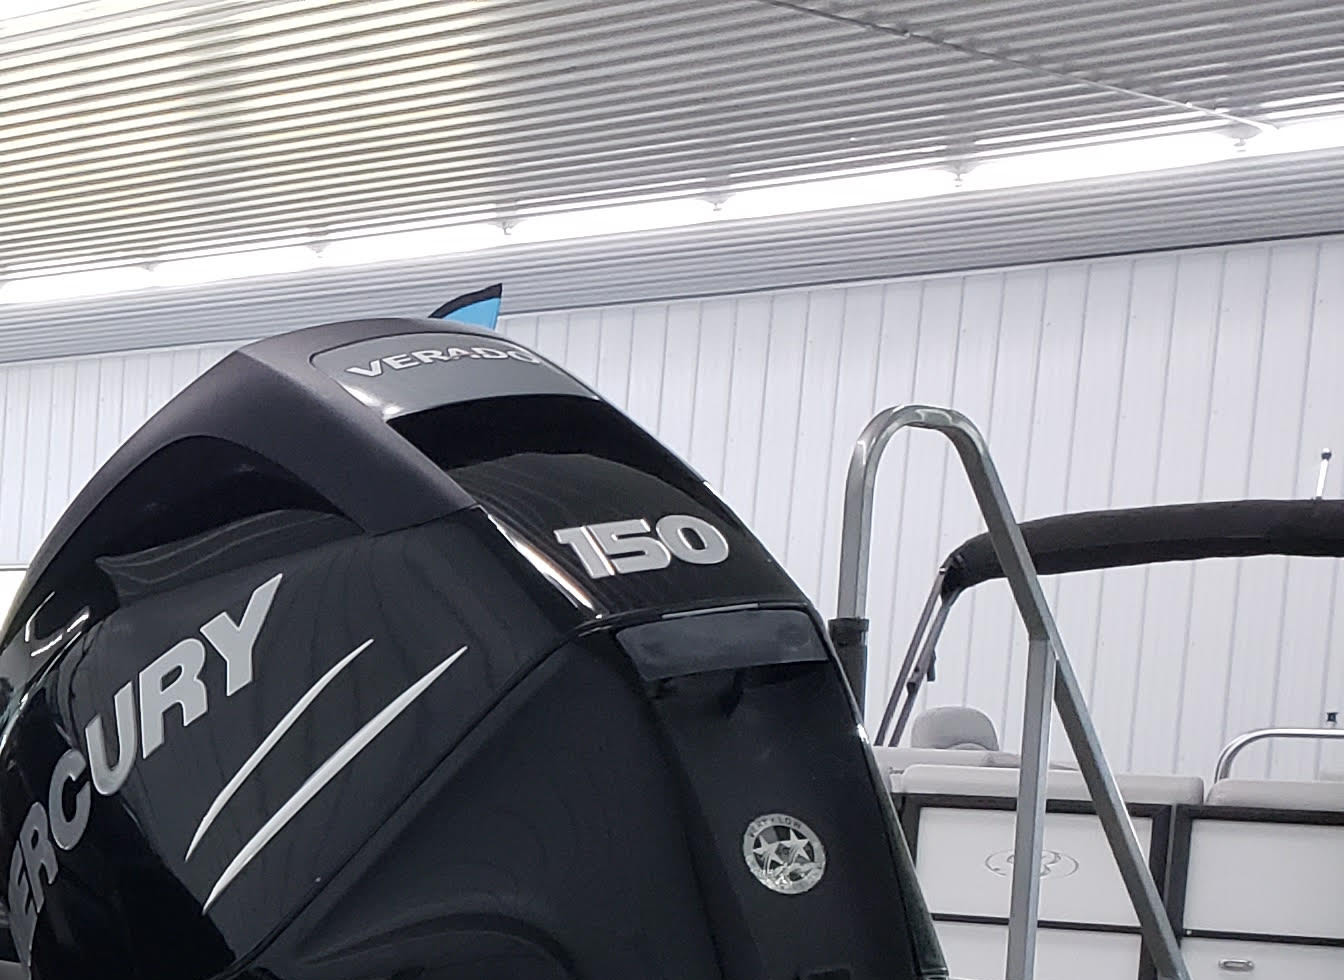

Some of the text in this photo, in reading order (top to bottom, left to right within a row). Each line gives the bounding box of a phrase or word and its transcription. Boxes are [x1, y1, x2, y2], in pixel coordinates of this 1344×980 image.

[346, 347, 540, 378] VERADO
[553, 515, 729, 580] 150
[8, 573, 283, 968] ERCURY
